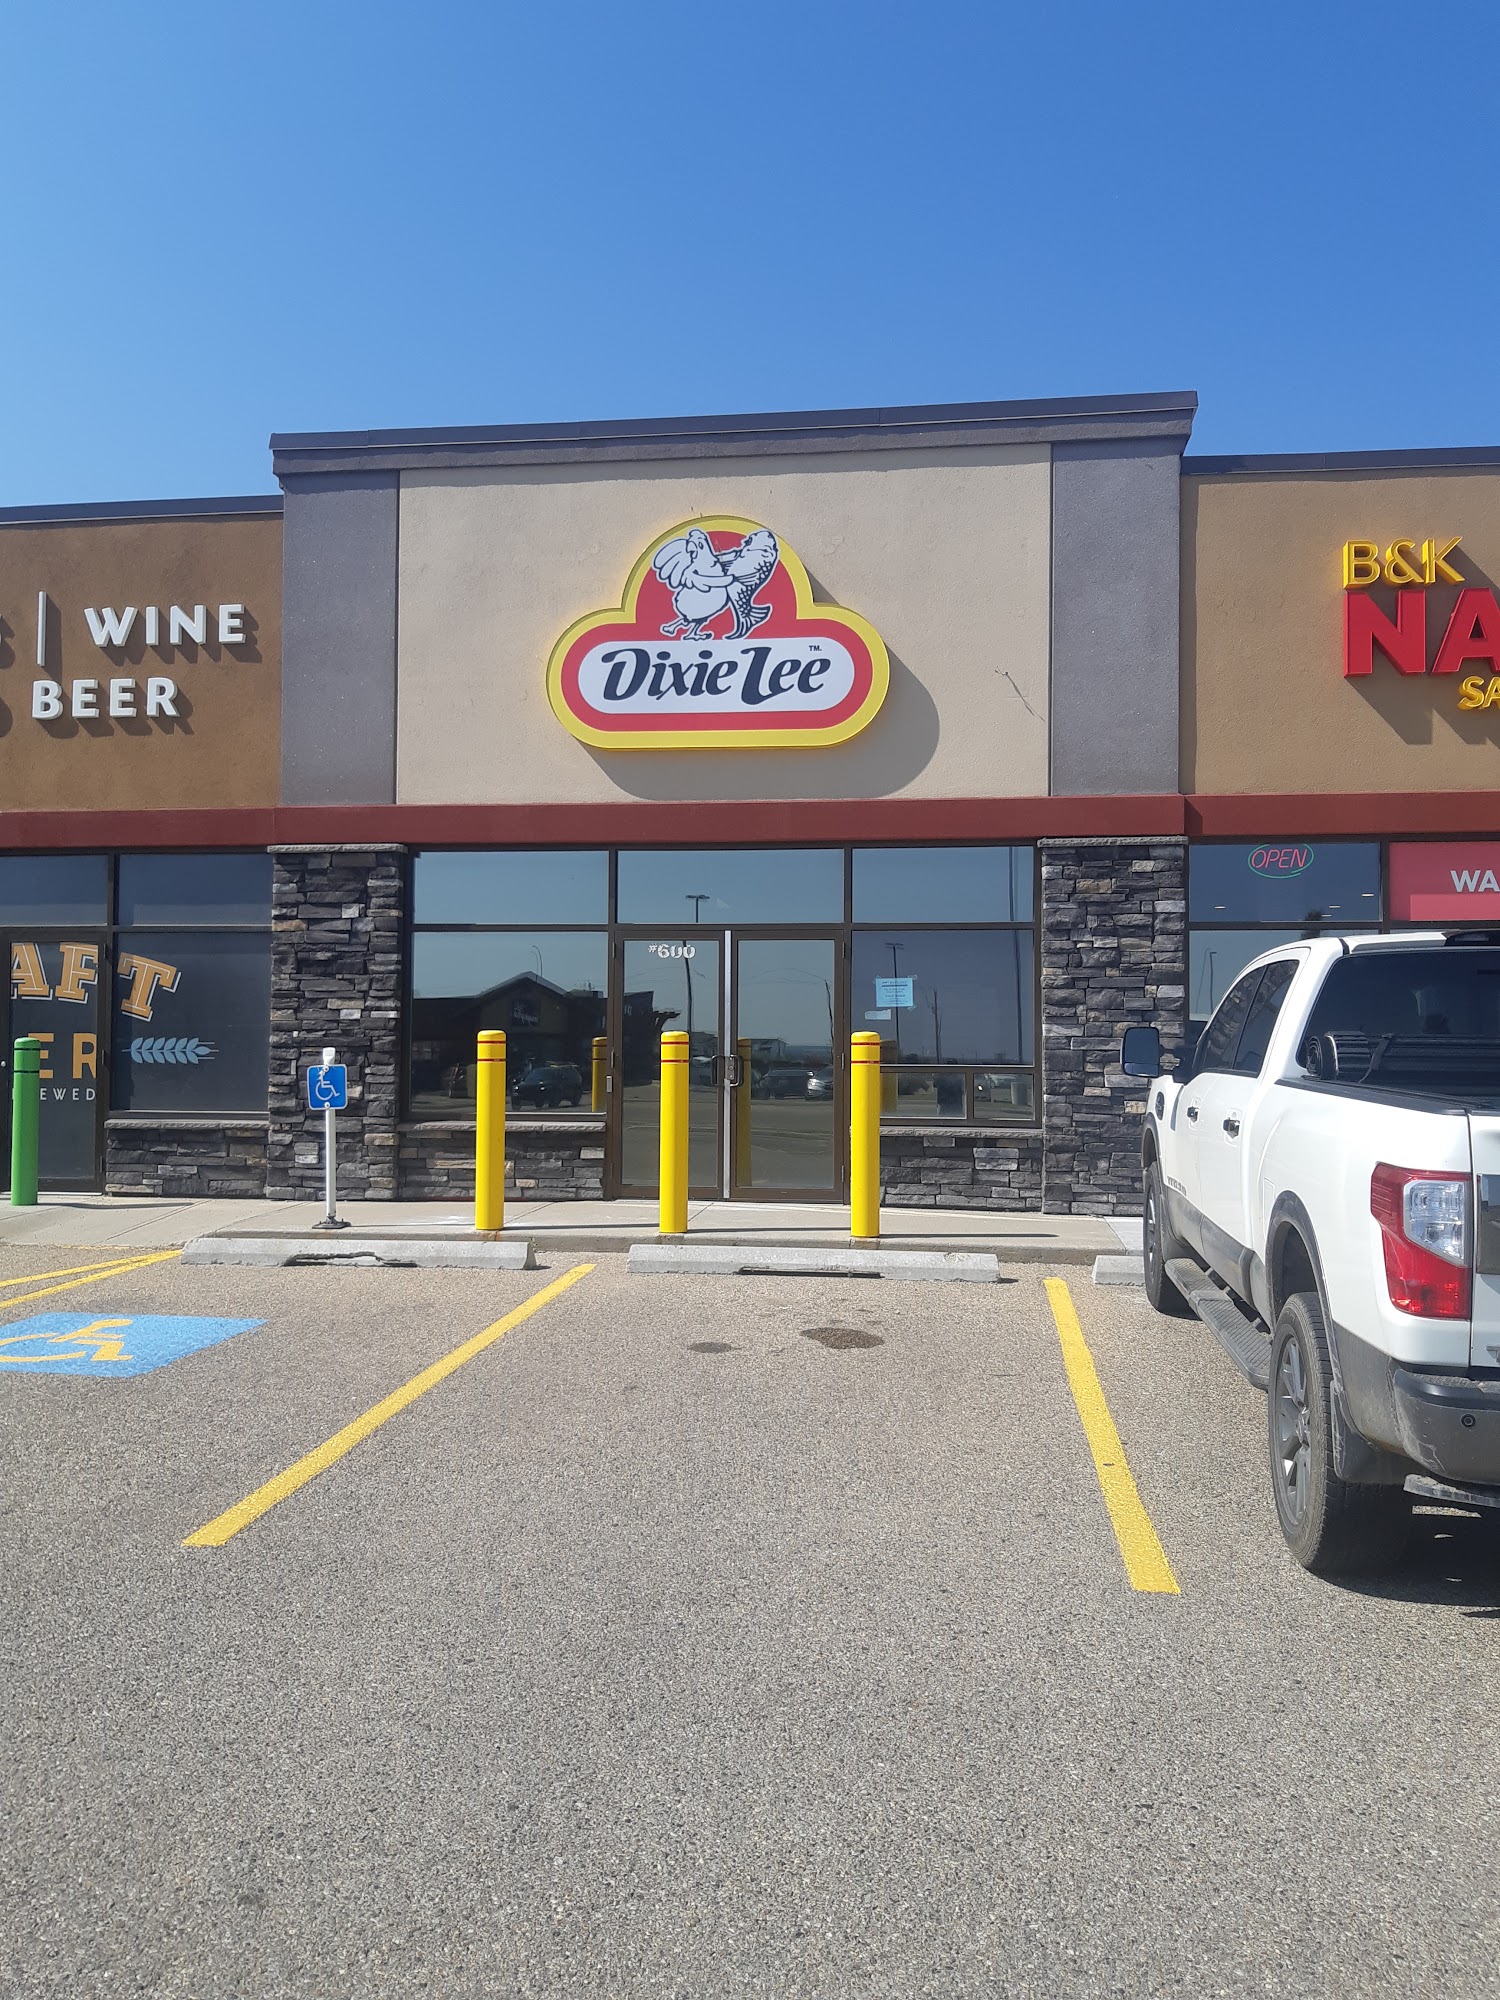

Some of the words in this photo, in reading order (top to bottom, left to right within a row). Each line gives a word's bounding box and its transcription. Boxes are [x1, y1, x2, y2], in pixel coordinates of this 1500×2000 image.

[1343, 536, 1466, 589] B&K
[84, 604, 246, 647] WINE
[1343, 587, 1500, 678] NA
[601, 647, 738, 701] Dixie
[740, 646, 832, 706] Lee
[32, 677, 180, 719] BEER
[1251, 848, 1308, 869] OPEN
[648, 943, 696, 959] #600
